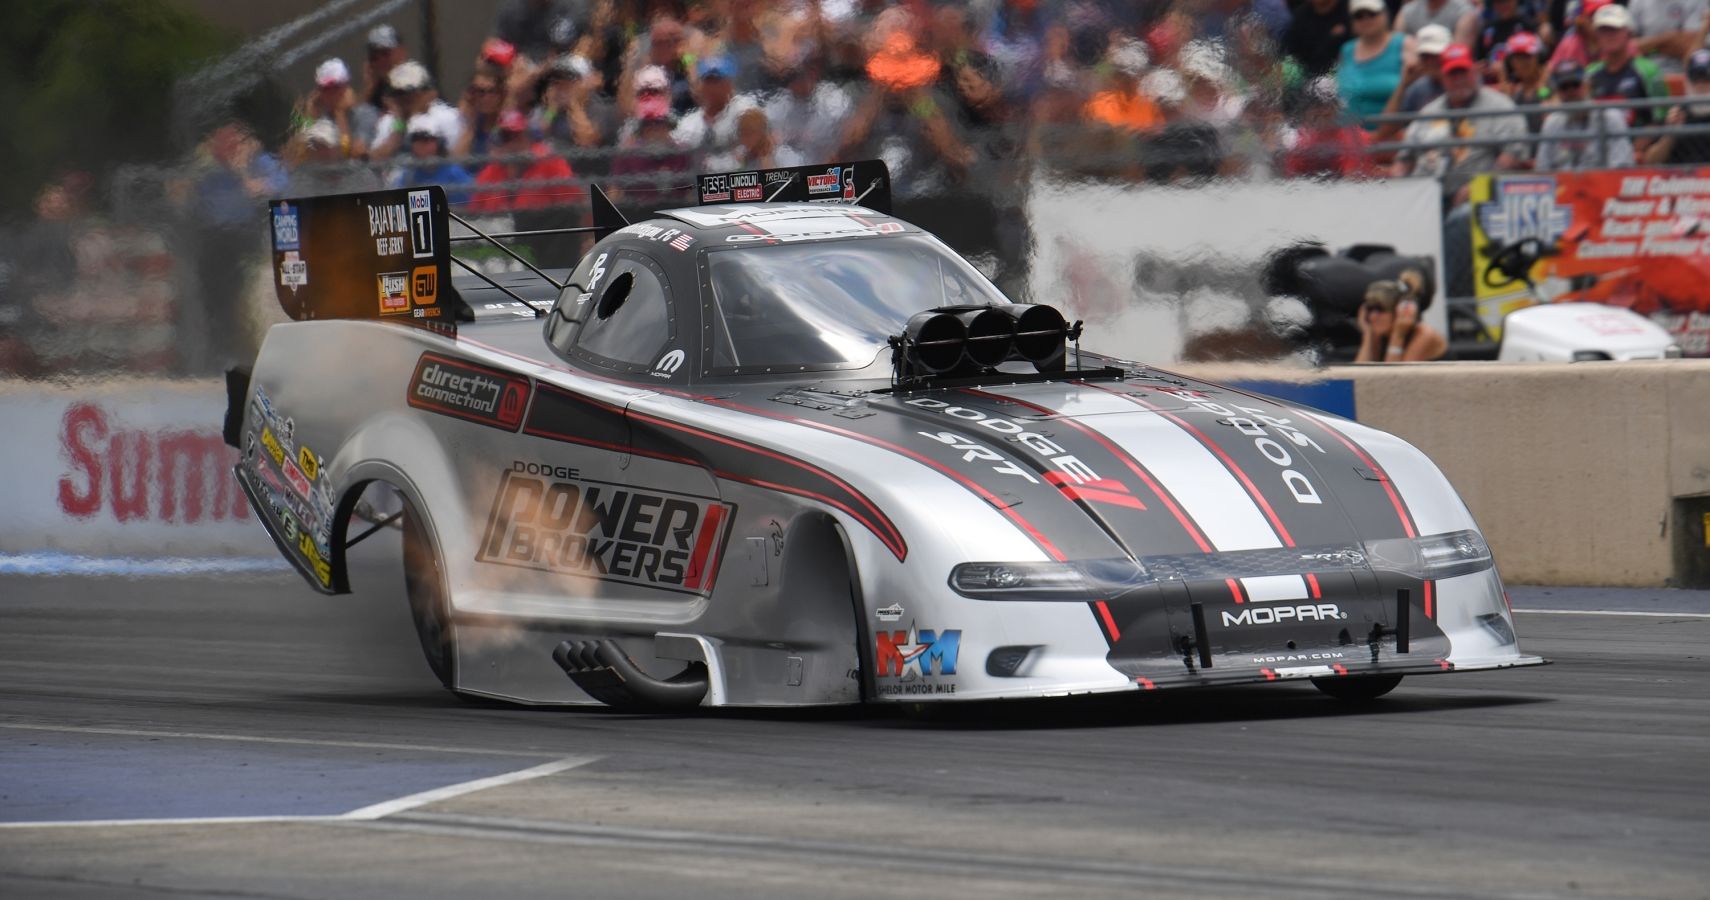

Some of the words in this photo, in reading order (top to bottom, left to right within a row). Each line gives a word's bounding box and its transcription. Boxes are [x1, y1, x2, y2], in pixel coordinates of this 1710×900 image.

[702, 175, 730, 195] JESEL
[730, 174, 757, 188] LINCOLN
[765, 171, 790, 183] TREND
[808, 175, 838, 187] VICTORY
[410, 194, 429, 209] Mobil
[737, 187, 760, 199] ELECTRIC
[274, 214, 298, 229] CAMPING
[276, 227, 299, 243] WORLD
[417, 214, 426, 250] 1
[376, 238, 388, 256] BEEF
[389, 236, 404, 255] JERKY
[422, 365, 484, 394] direct
[417, 383, 495, 413] connection
[1229, 403, 1327, 454] SRT
[905, 397, 1102, 485] DODGE
[1164, 390, 1323, 505] DODGE
[917, 431, 1041, 485] SRT
[513, 460, 580, 480] DODGE
[492, 475, 699, 557] POWER
[507, 526, 690, 584] BROKERS
[1252, 651, 1344, 663] MOPAR.COM
[878, 684, 902, 695] SHELOR
[905, 684, 933, 695] MOTOR
[935, 684, 956, 694] MILE
